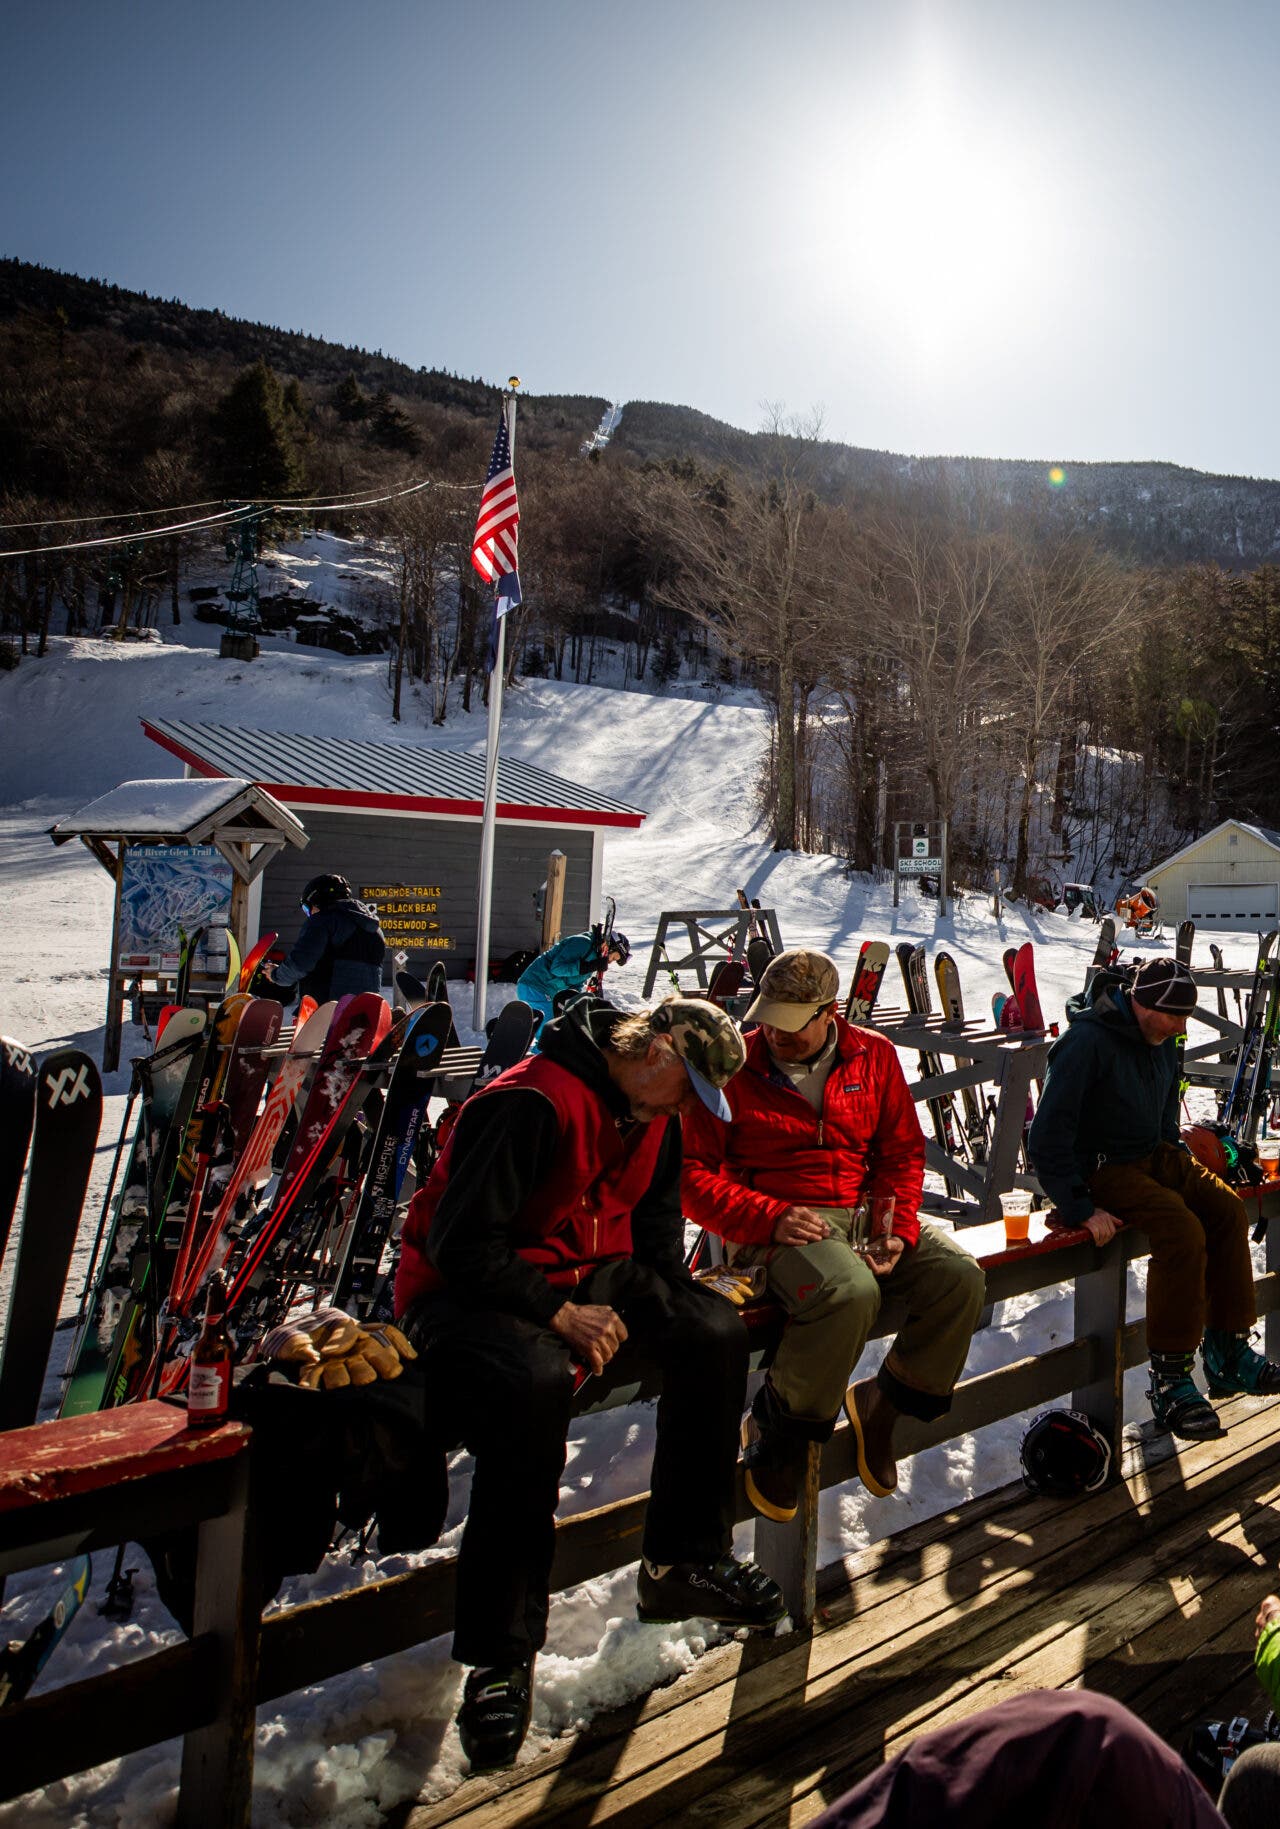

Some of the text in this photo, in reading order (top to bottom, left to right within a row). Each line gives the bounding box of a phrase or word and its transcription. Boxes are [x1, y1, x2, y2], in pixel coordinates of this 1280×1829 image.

[144, 848, 168, 857] River
[169, 847, 189, 856] Glen
[191, 847, 212, 856] Trail
[363, 887, 441, 898] SNOWSHOE TRAILS
[386, 903, 437, 914] BLACK BEAR
[384, 936, 449, 947] NOWSHOE HARE
[195, 1077, 211, 1112] HEAD
[399, 1107, 421, 1165] DYNASTAR
